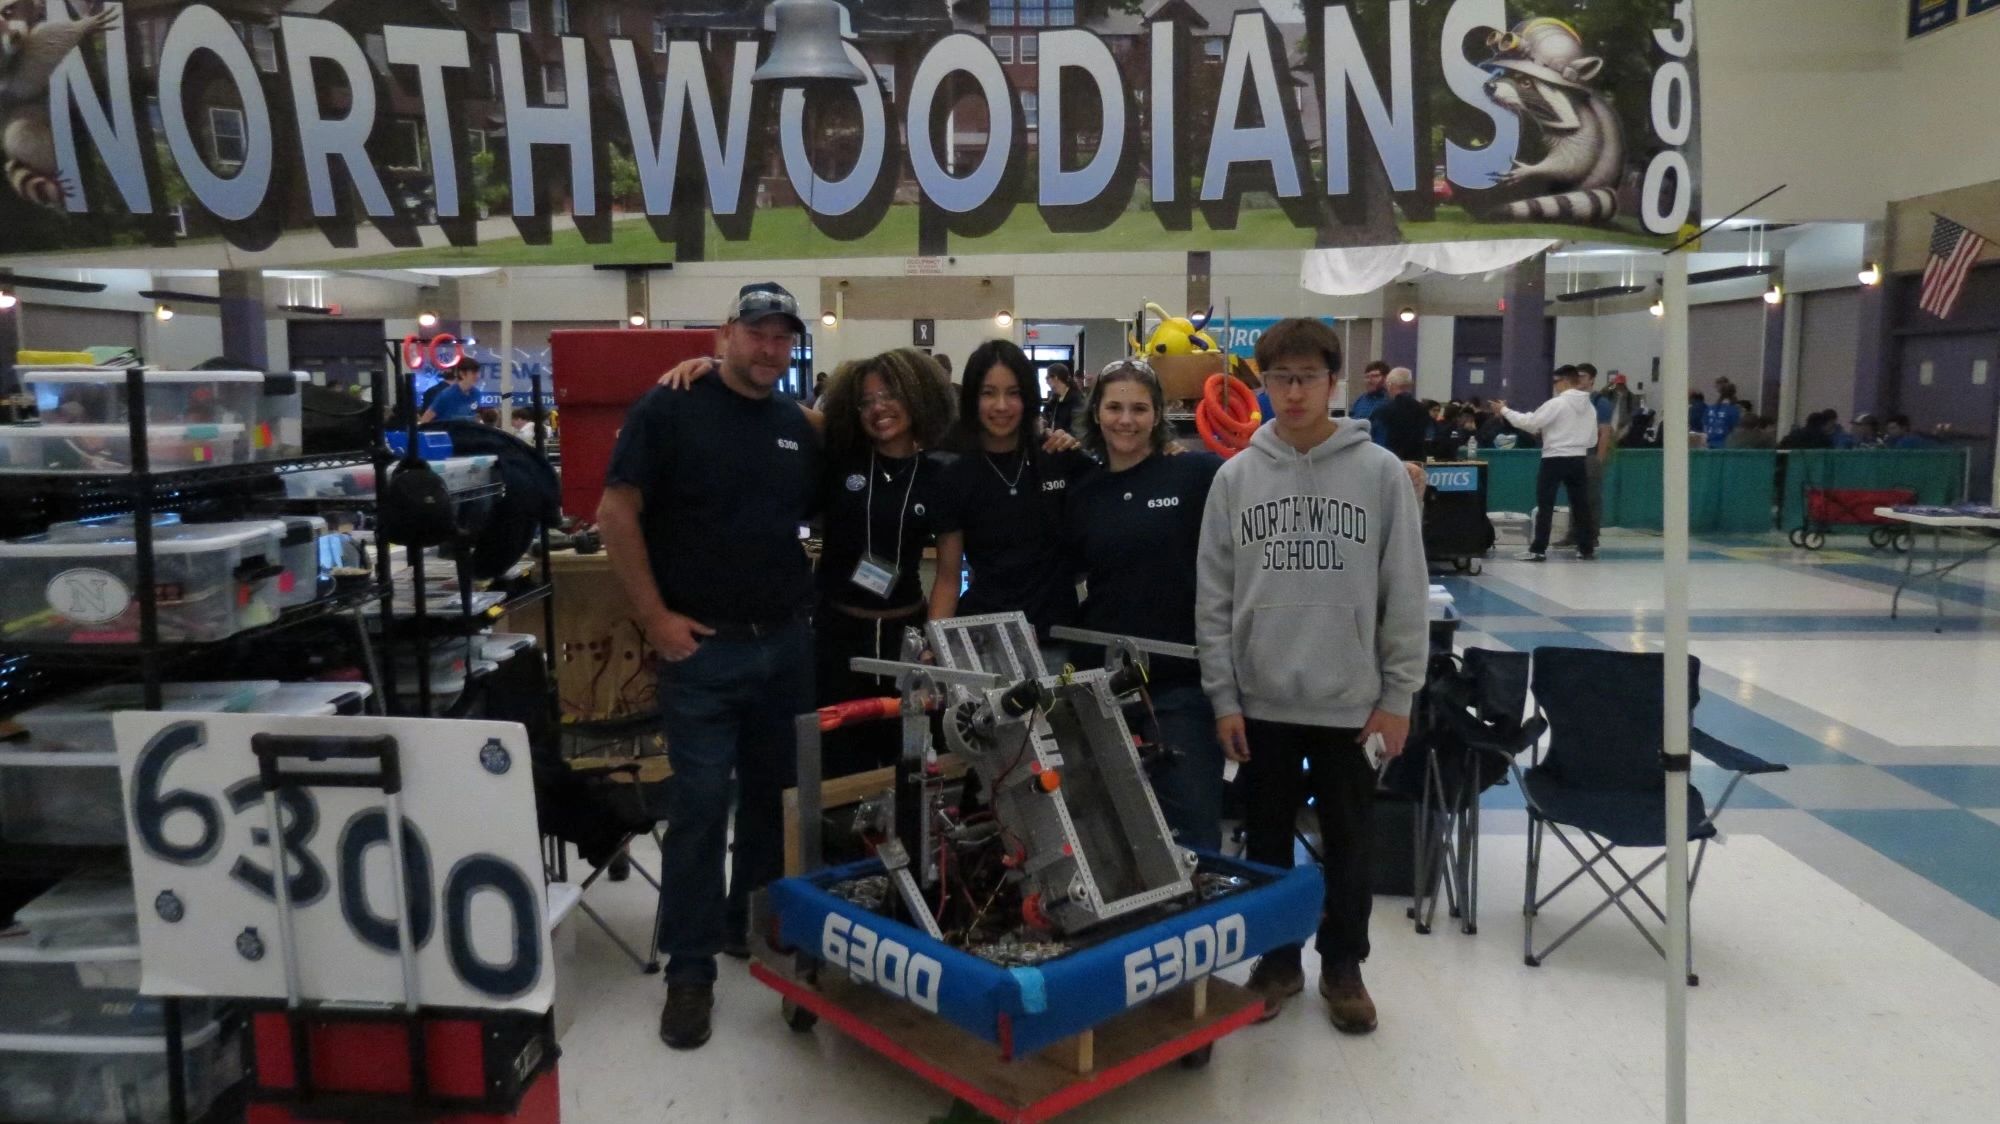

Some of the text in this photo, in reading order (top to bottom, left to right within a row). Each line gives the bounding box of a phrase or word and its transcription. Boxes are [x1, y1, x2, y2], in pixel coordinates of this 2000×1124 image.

[47, 0, 1520, 221] NORTHWOODIANS
[778, 438, 798, 451] 6300
[1147, 496, 1179, 508] 6300
[1241, 496, 1367, 546] NORTHWOOD
[1262, 540, 1344, 570] SCHOOL
[131, 720, 542, 999] 6300
[822, 911, 942, 1014] 6300
[1124, 912, 1246, 1007] 6300
